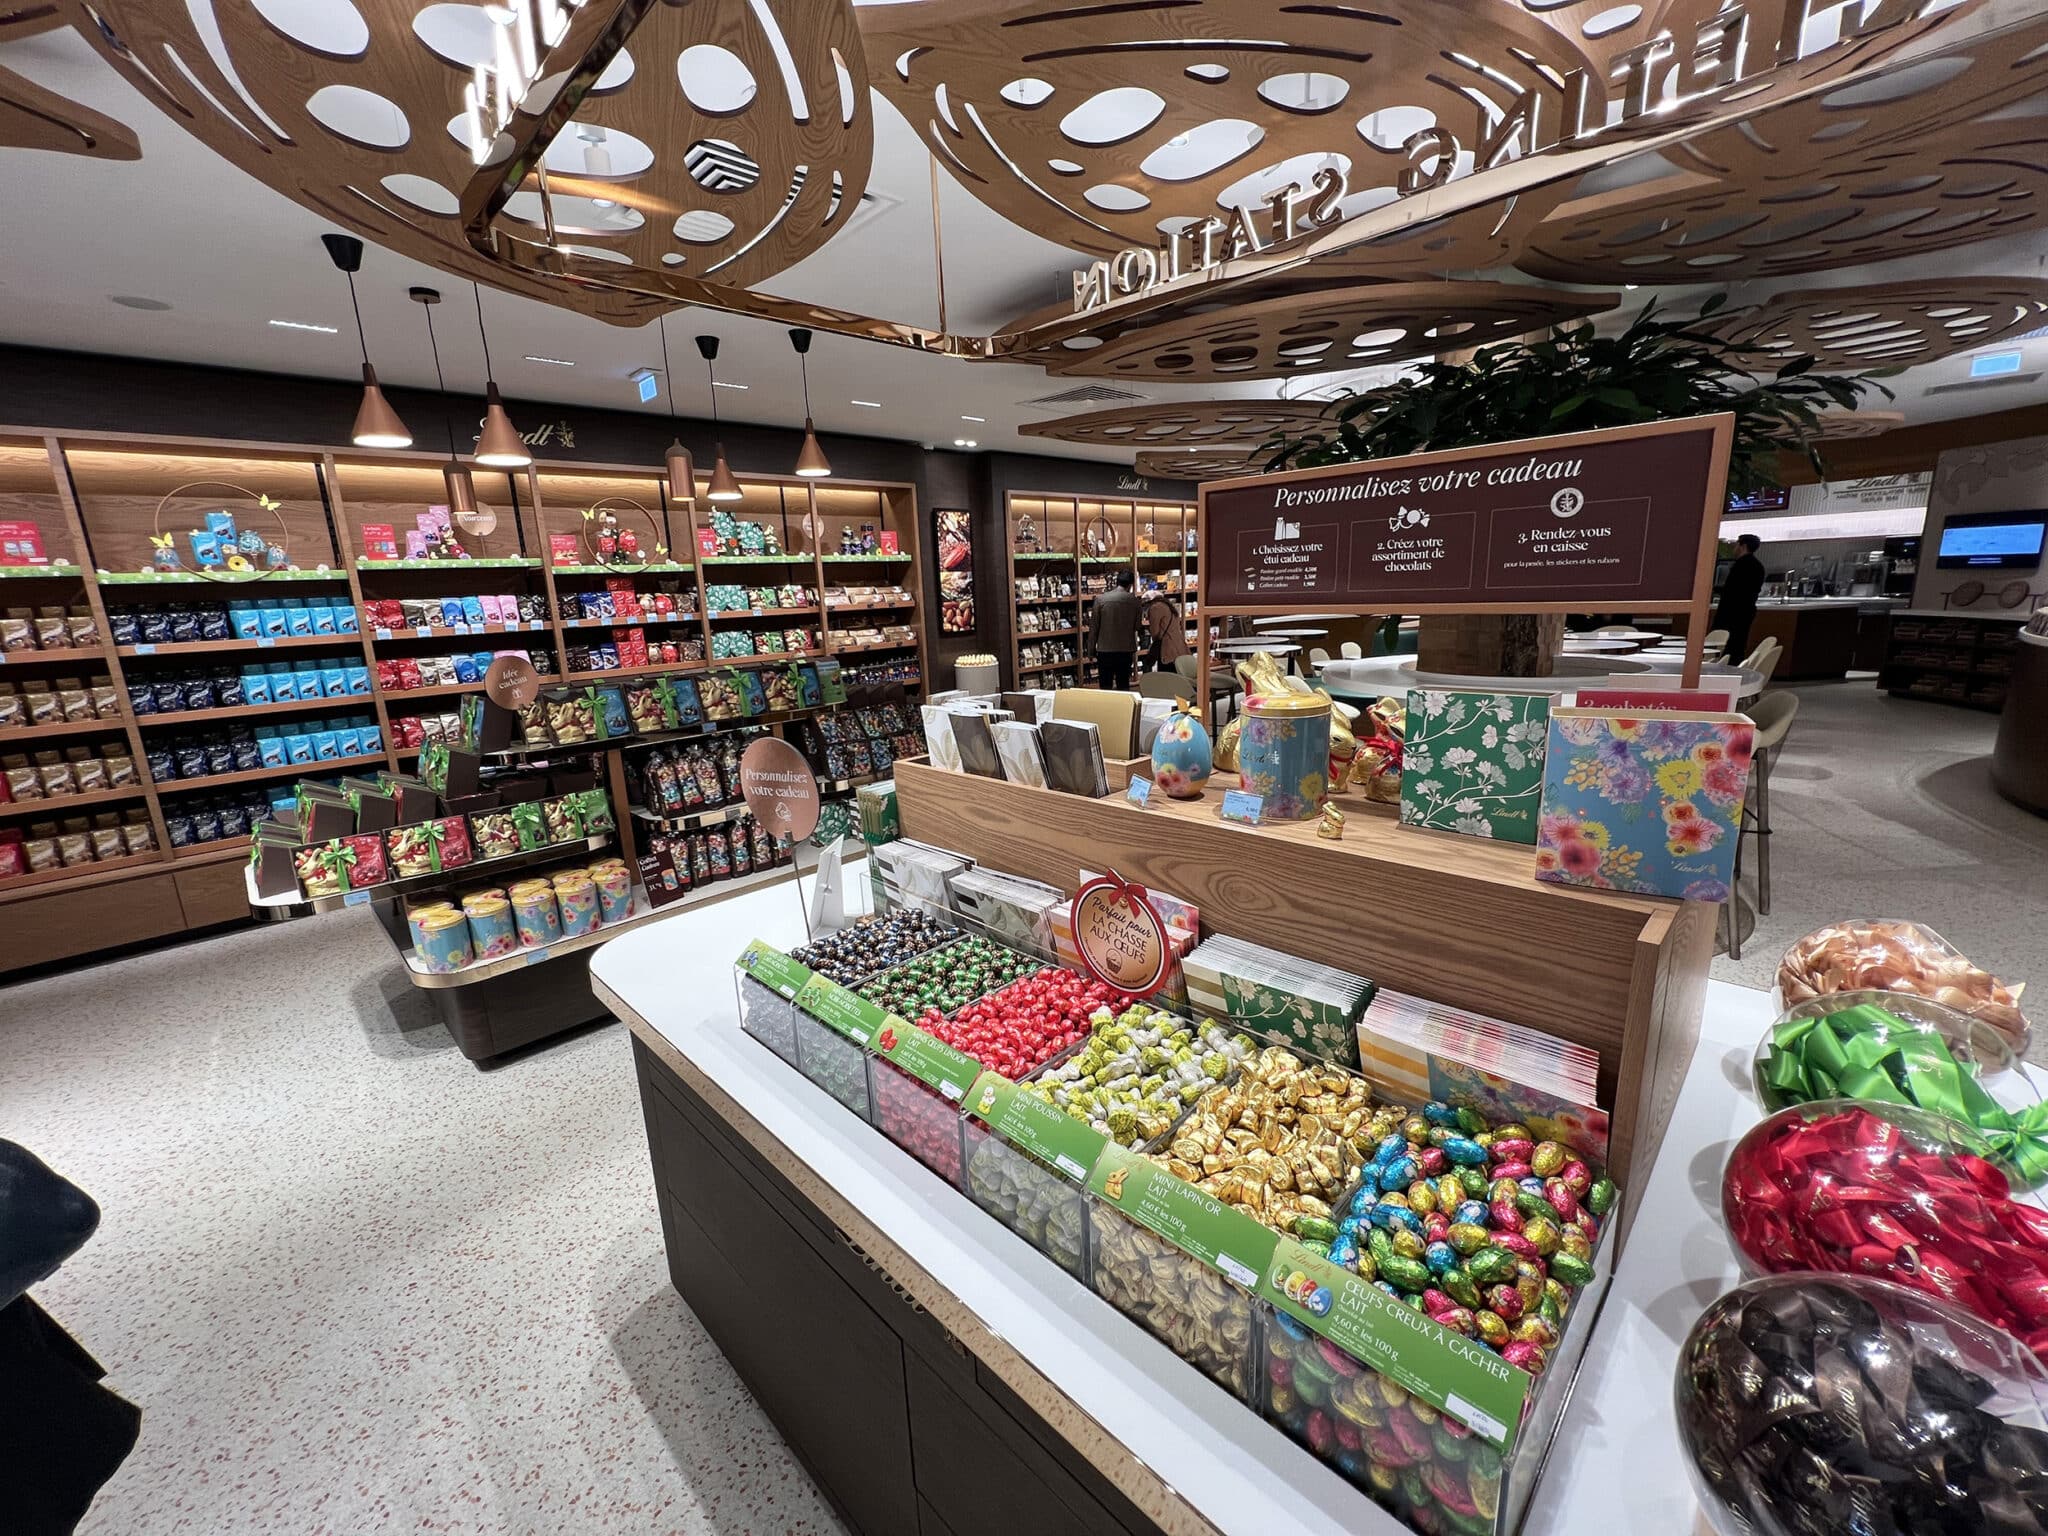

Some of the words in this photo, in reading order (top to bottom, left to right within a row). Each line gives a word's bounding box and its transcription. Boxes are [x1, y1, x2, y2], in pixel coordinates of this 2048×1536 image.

[1117, 475, 1142, 490] Lindt
[1274, 478, 1412, 508] Personnalisez
[1418, 469, 1481, 492] votre
[1487, 457, 1584, 485] cadeau
[1258, 543, 1300, 555] Choisissez
[1301, 543, 1323, 552] votre
[1386, 538, 1415, 549] Créez
[1417, 538, 1444, 547] votre
[1533, 543, 1548, 553] en
[1550, 540, 1589, 552] caisse
[1263, 555, 1279, 565] étui
[1280, 553, 1310, 564] cadeau
[1372, 549, 1429, 561] assortiment
[1431, 547, 1445, 558] de
[1384, 560, 1432, 572] chocolats
[502, 669, 518, 680] Idée
[498, 676, 528, 689] cadeau
[745, 768, 808, 784] Personnalisez
[750, 785, 774, 797] votre
[775, 785, 809, 799] cadeau
[1491, 806, 1520, 818] Lindt
[1092, 896, 1127, 924] Parfait
[1126, 920, 1153, 938] pour
[1092, 912, 1105, 927] LA
[1107, 921, 1148, 953] CHASSE
[1089, 925, 1111, 944] AUX
[1113, 938, 1146, 965] ŒUFS
[907, 1038, 920, 1049] LAIT
[1010, 1099, 1027, 1112] LAIT
[1016, 1092, 1031, 1106] MINI
[1031, 1099, 1063, 1123] POUSSIN
[1147, 1183, 1169, 1198] LAIT
[1152, 1172, 1175, 1189] MINI
[1175, 1183, 1204, 1205] LAPIN
[1205, 1201, 1222, 1217] OR
[1141, 1200, 1154, 1211] 4,60
[1159, 1208, 1169, 1220] les
[1169, 1214, 1182, 1228] 100
[1288, 1249, 1323, 1273] Lindt
[1340, 1292, 1369, 1316] LAIT
[1332, 1314, 1352, 1332] 4,60
[1352, 1323, 1360, 1335] €
[1360, 1326, 1373, 1343] les
[1375, 1338, 1393, 1356] 100
[1391, 1350, 1400, 1362] g
[1345, 1279, 1384, 1310] ŒUFS
[1386, 1303, 1431, 1337] CREUX
[1433, 1327, 1445, 1345] À
[1448, 1339, 1511, 1383] CACHER
